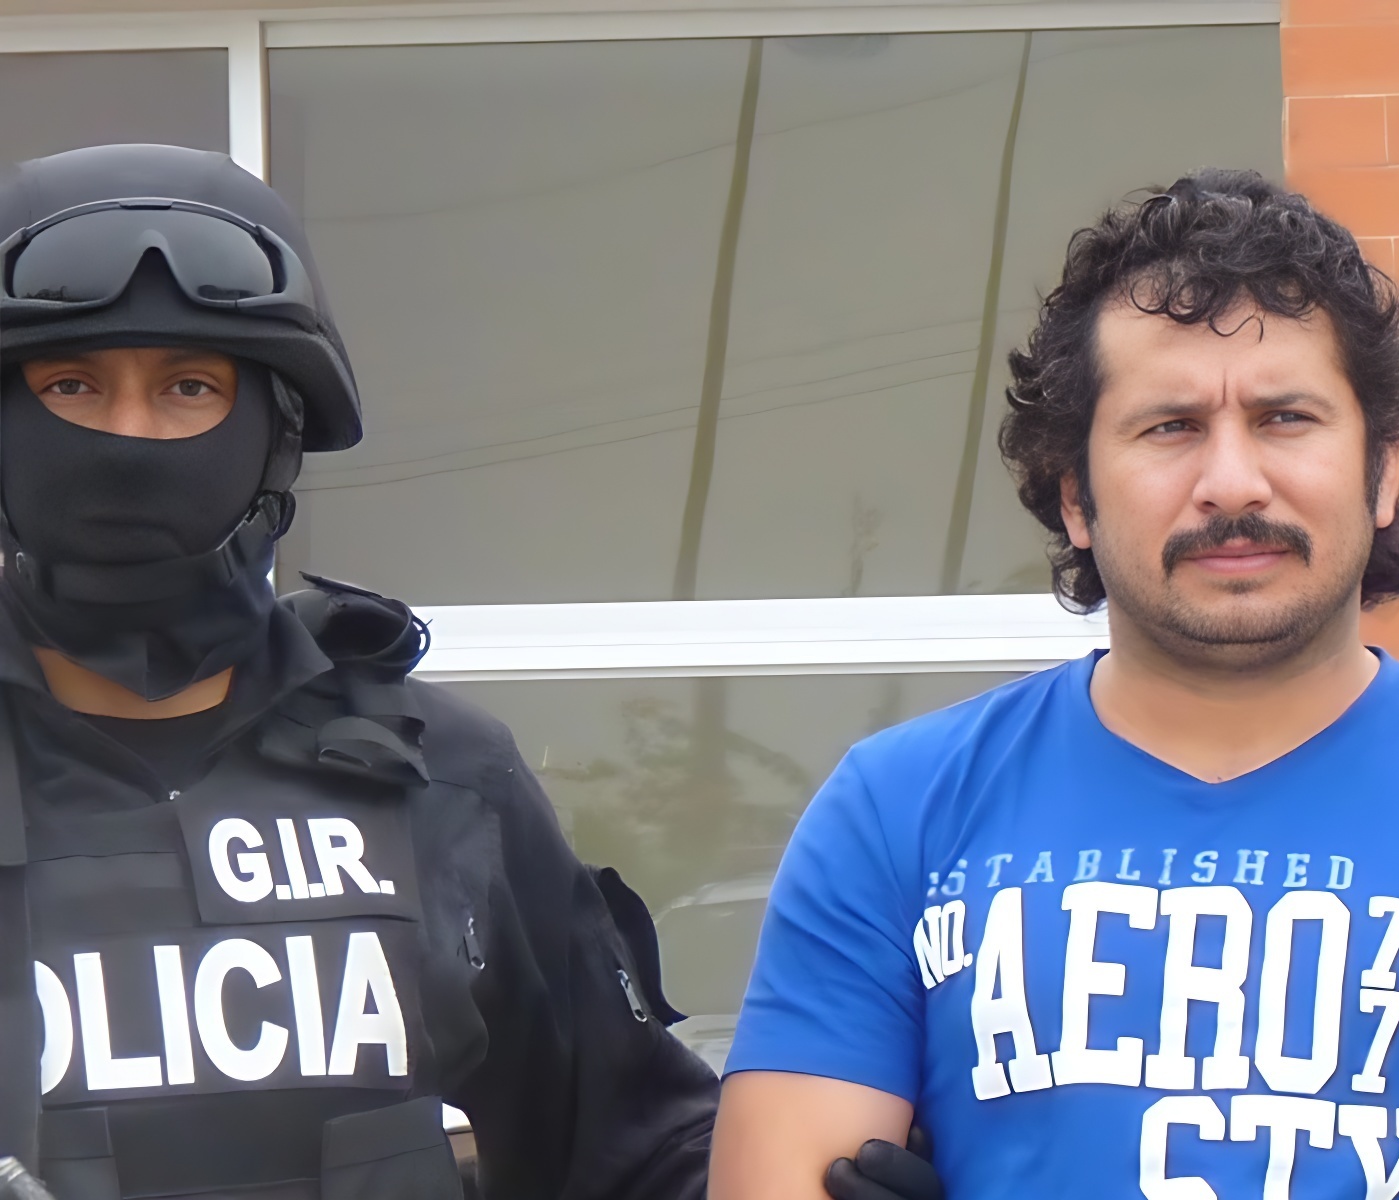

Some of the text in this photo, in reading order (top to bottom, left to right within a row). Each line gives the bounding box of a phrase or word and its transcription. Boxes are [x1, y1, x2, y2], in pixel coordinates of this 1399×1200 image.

[207, 817, 396, 903] G.I.R.
[912, 899, 973, 990] NO.
[971, 881, 1351, 1101] AERO
